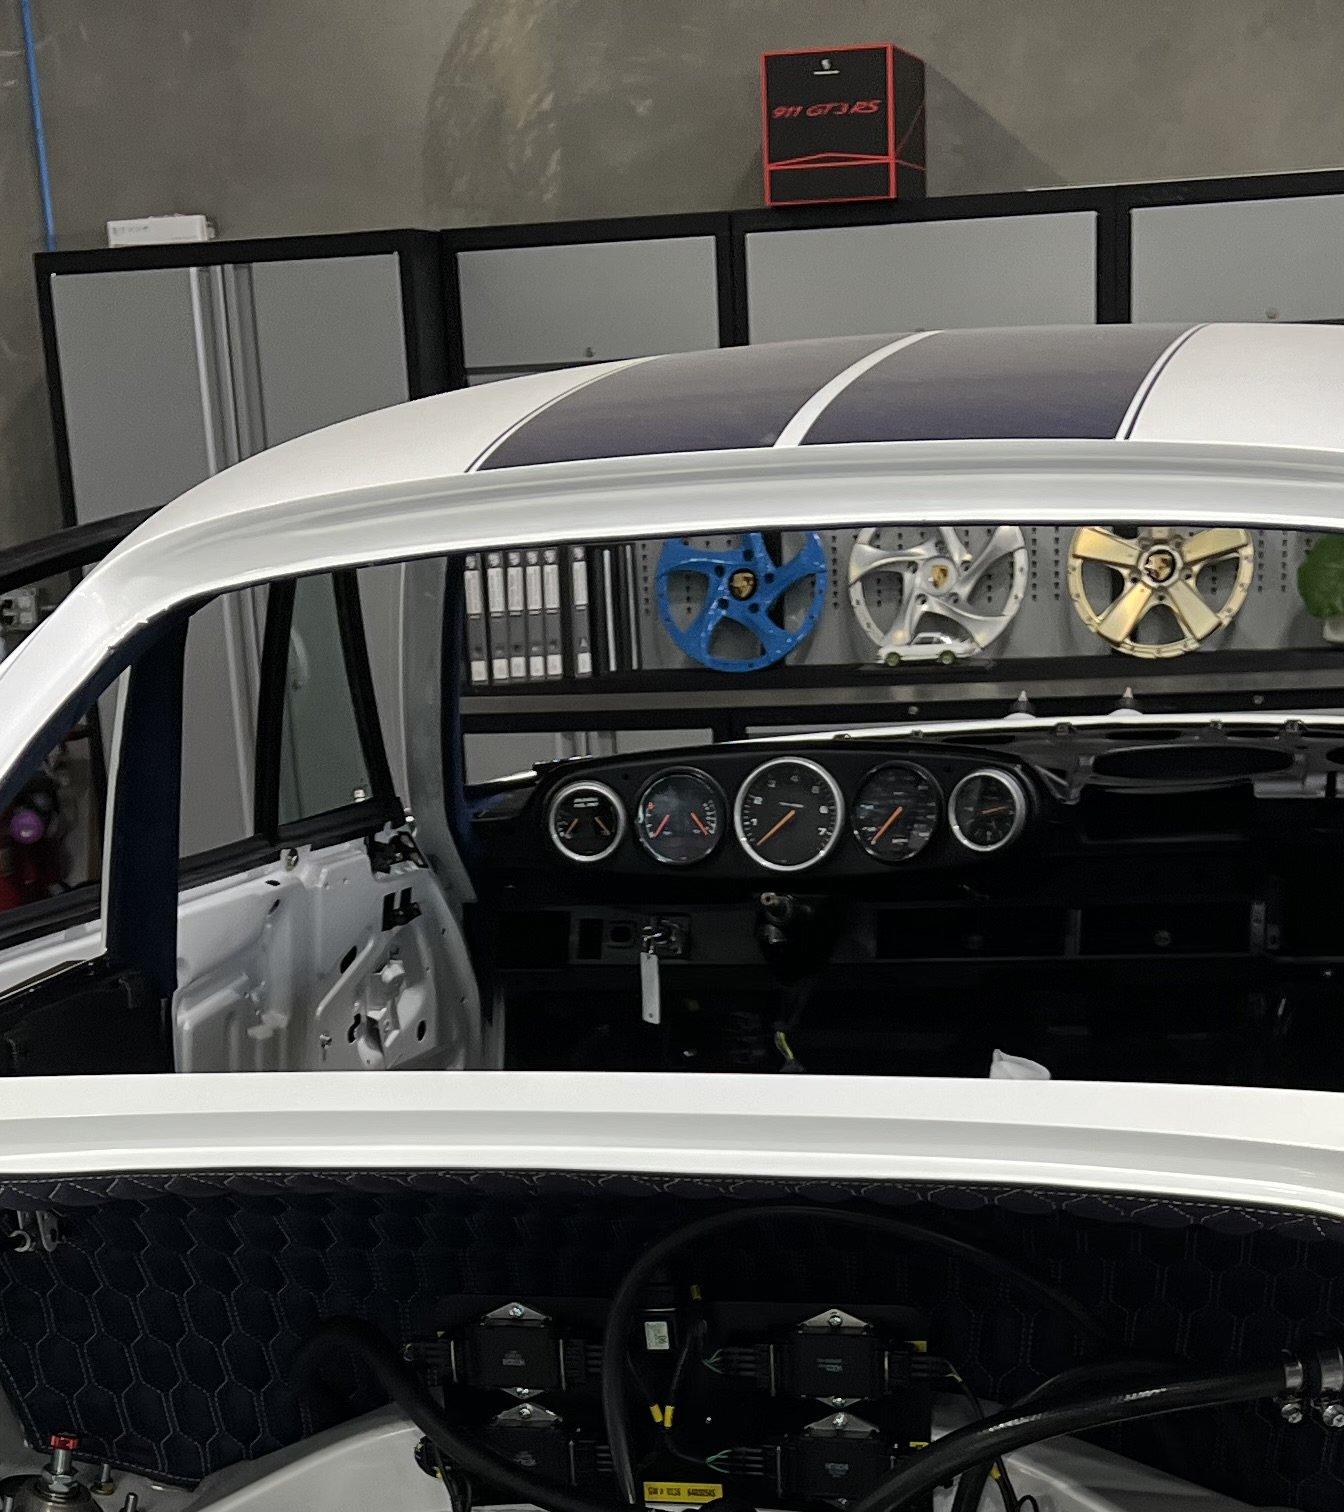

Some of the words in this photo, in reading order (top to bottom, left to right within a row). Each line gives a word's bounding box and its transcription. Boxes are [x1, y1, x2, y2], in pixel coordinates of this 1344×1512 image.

[773, 106, 803, 117] 911
[806, 103, 849, 117] GT3
[850, 100, 882, 114] RS
